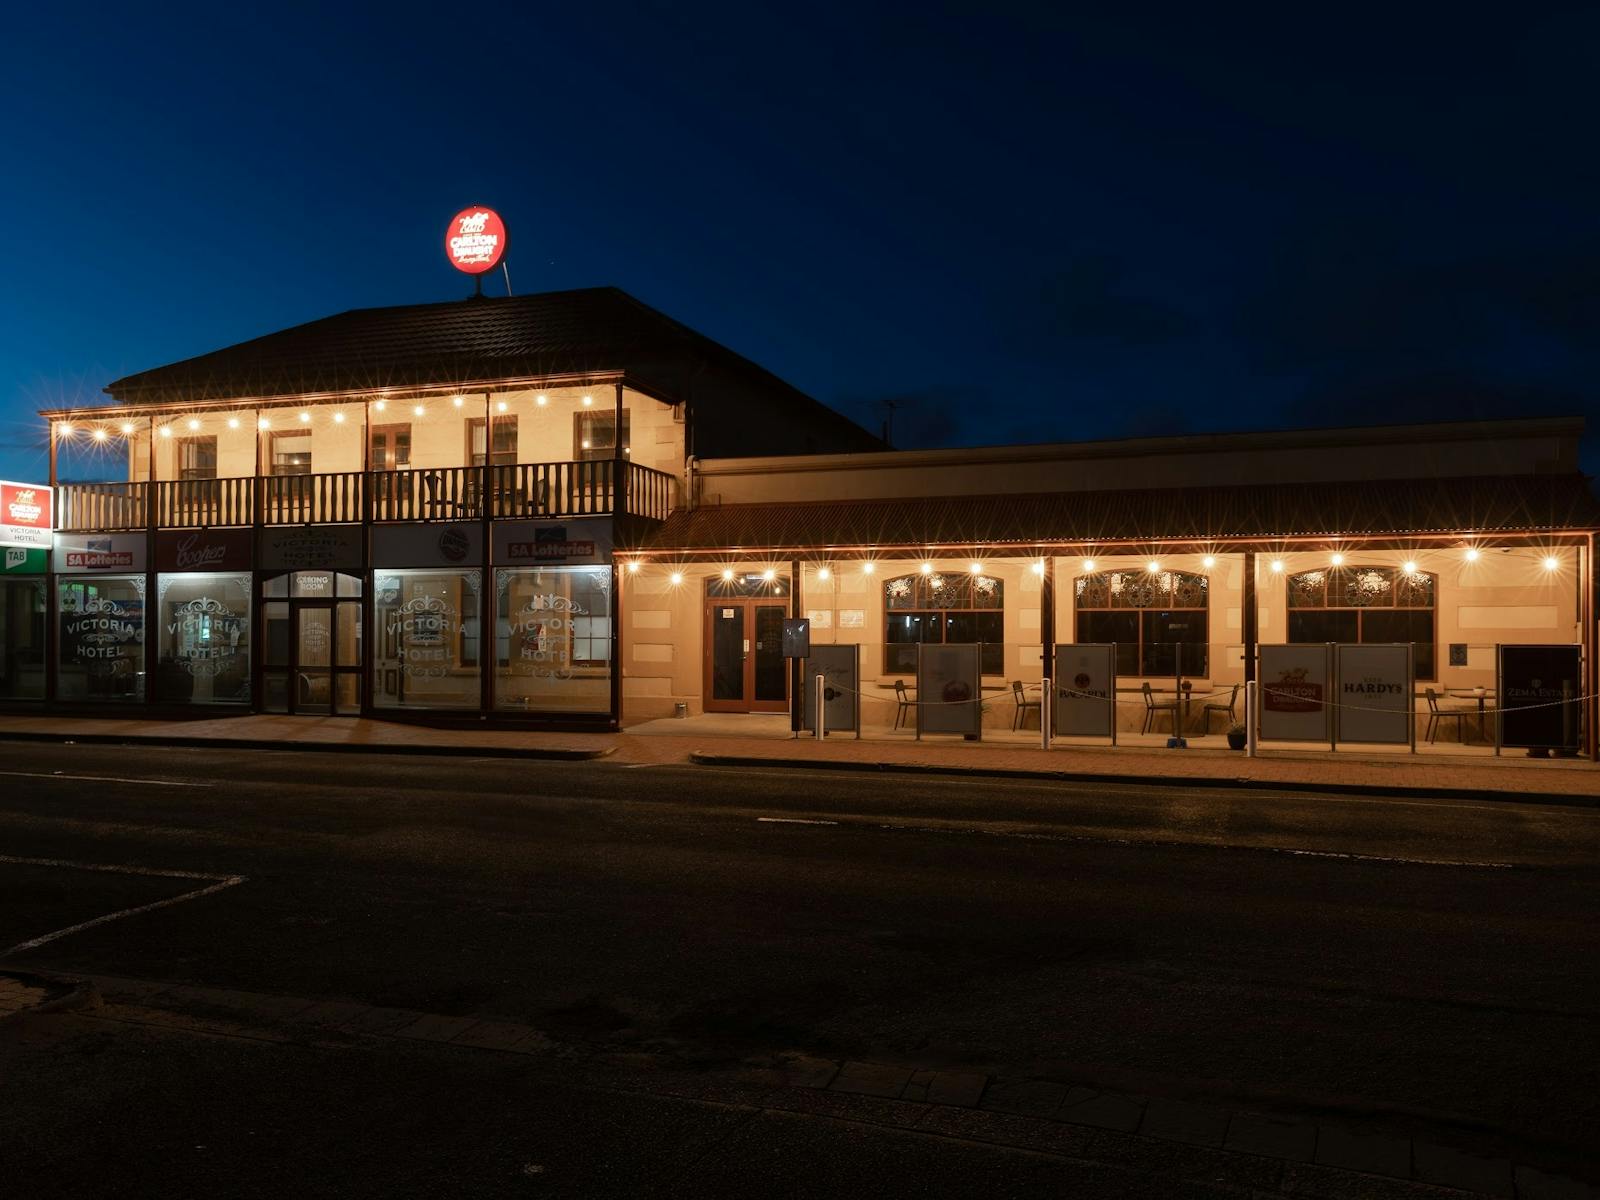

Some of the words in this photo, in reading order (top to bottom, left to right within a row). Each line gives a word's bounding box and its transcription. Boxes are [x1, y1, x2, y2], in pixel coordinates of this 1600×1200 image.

[8, 551, 25, 561] TAB
[511, 544, 530, 556] SA
[532, 543, 592, 556] Lotteries
[68, 555, 82, 566] SA
[84, 554, 132, 566] Lotteries
[67, 618, 134, 635] VICTORIA
[168, 618, 238, 635] VICTORIA
[387, 618, 468, 635] VICTORIA
[77, 645, 125, 659] HOTEL
[178, 646, 229, 659] HOTEL
[397, 647, 454, 661] HOTEL
[1344, 683, 1402, 694] HARDYS
[1507, 687, 1537, 697] ZEMA
